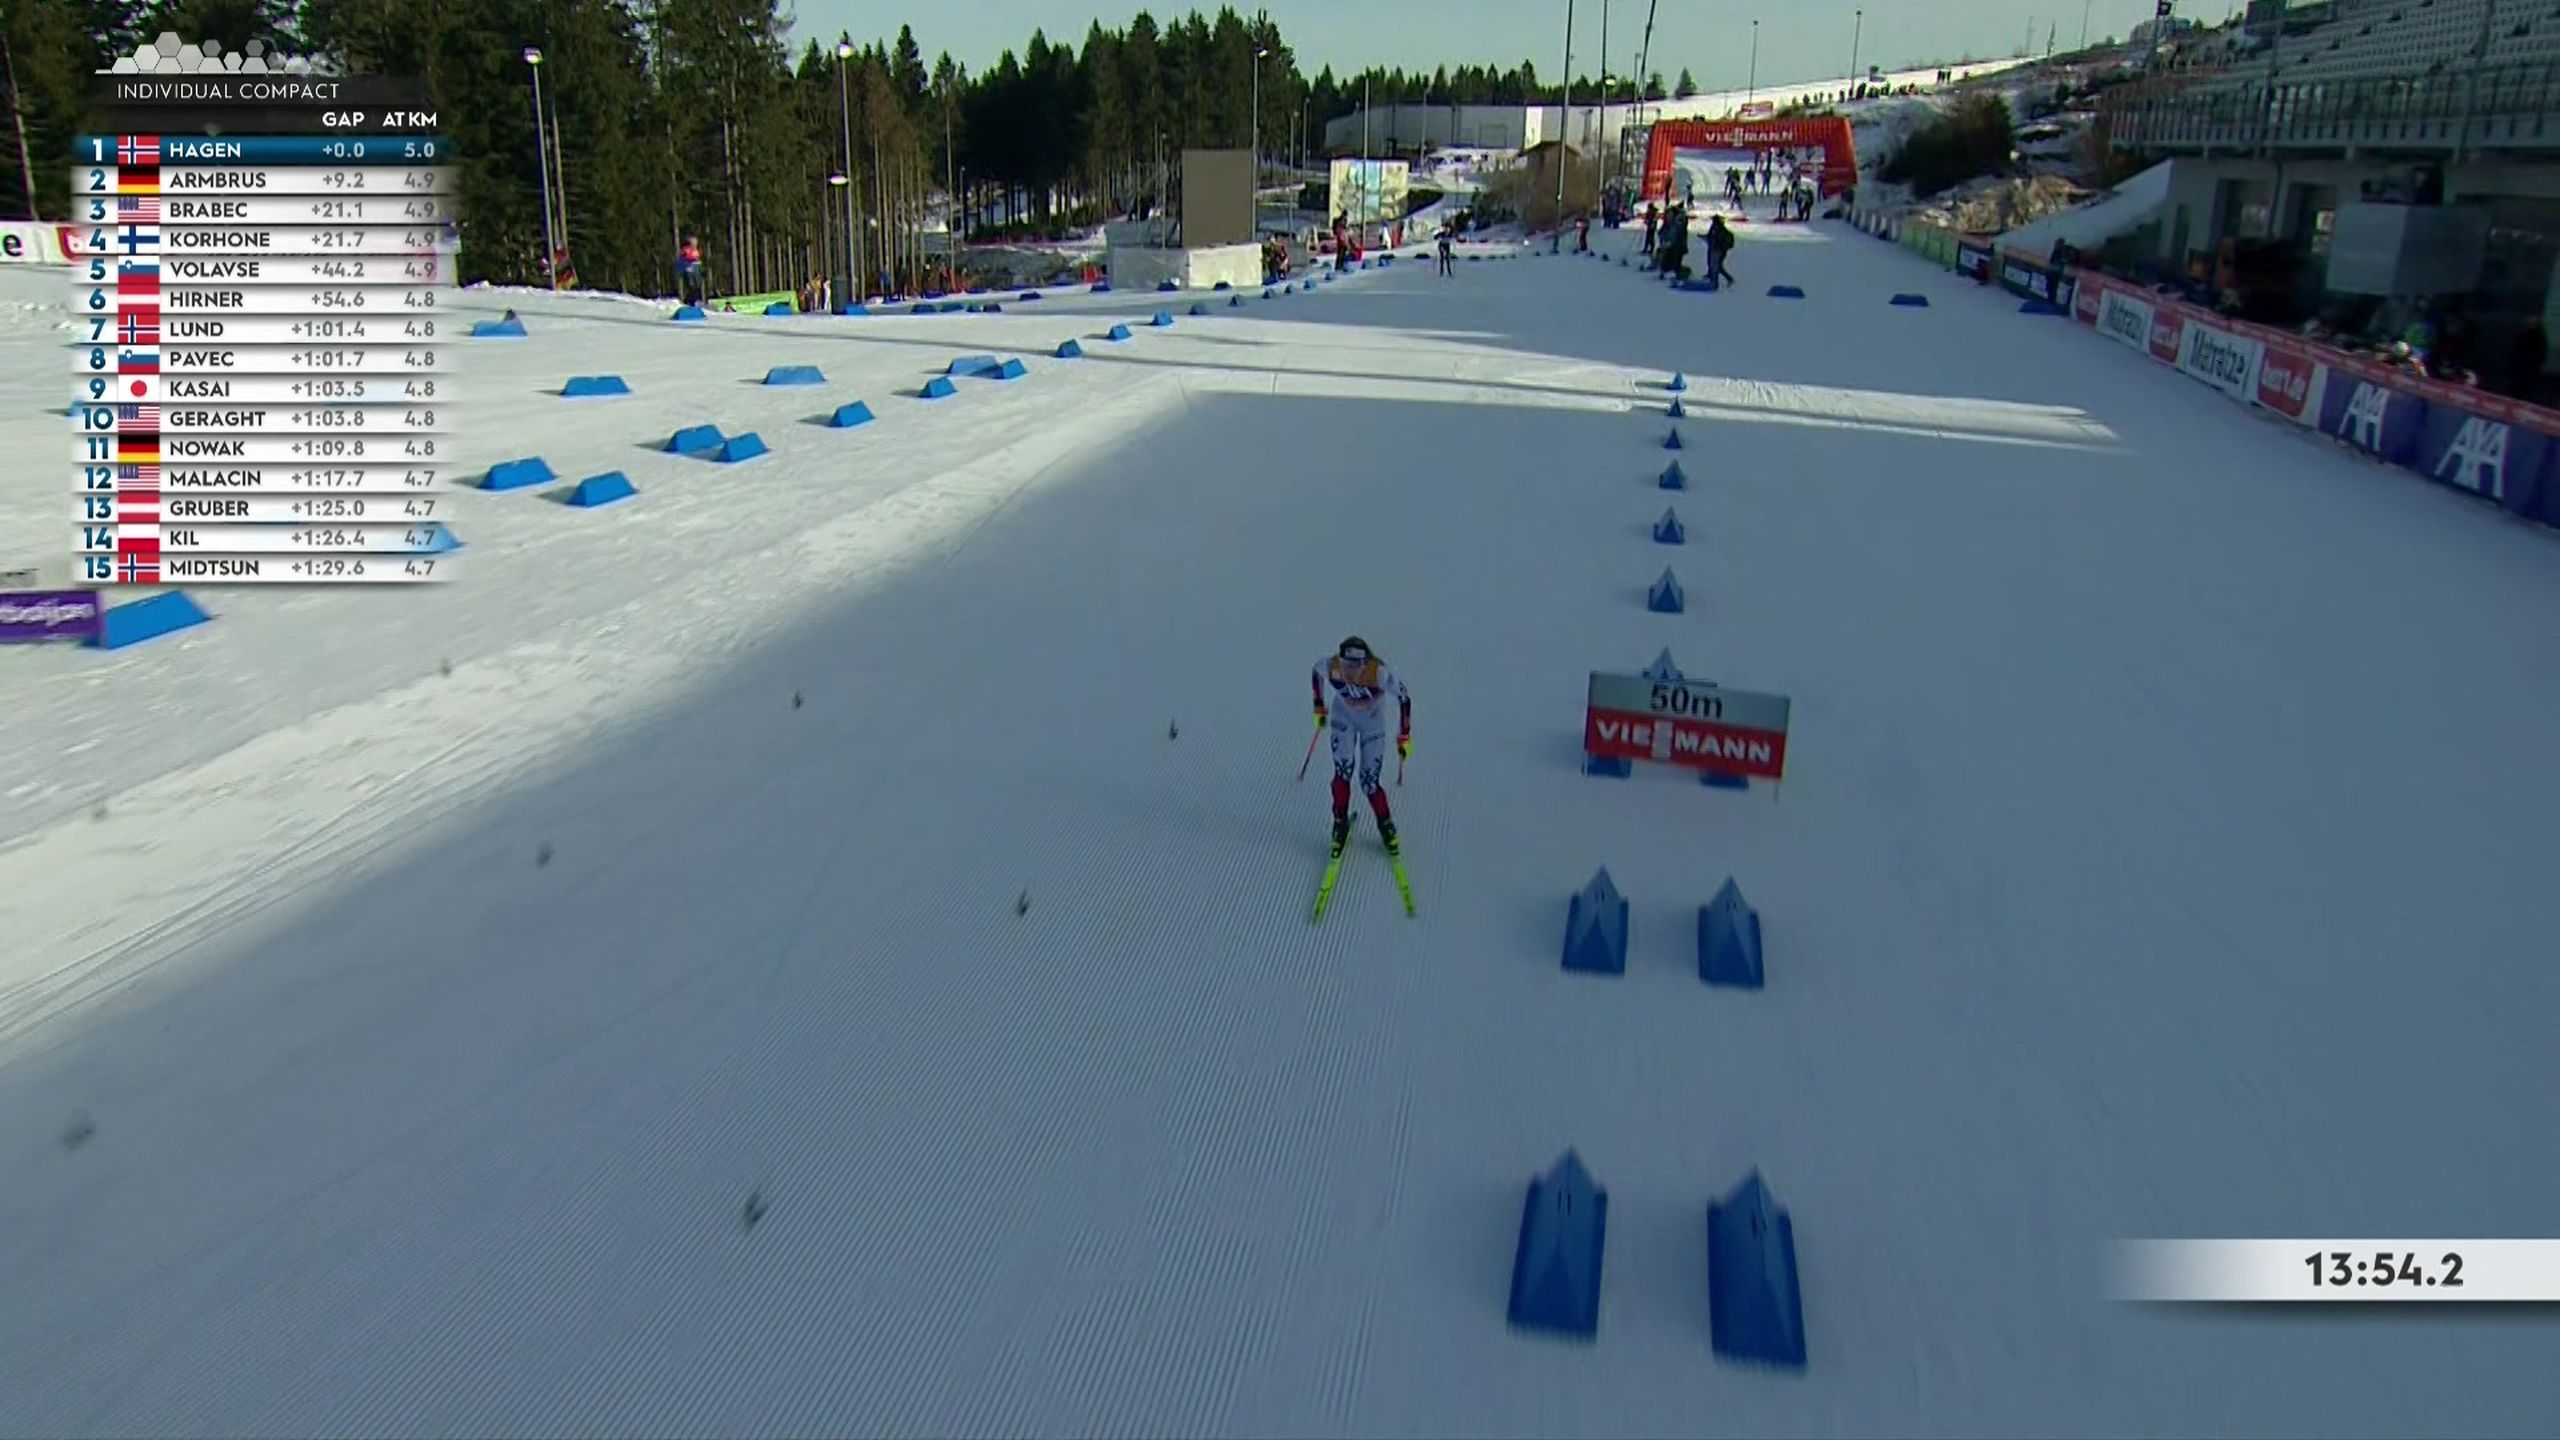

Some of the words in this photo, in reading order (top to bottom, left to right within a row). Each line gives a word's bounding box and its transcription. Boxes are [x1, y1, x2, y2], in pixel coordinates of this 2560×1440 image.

[2338, 380, 2391, 451] AXA
[2434, 416, 2511, 498] AXA
[1650, 683, 1723, 720] 50m
